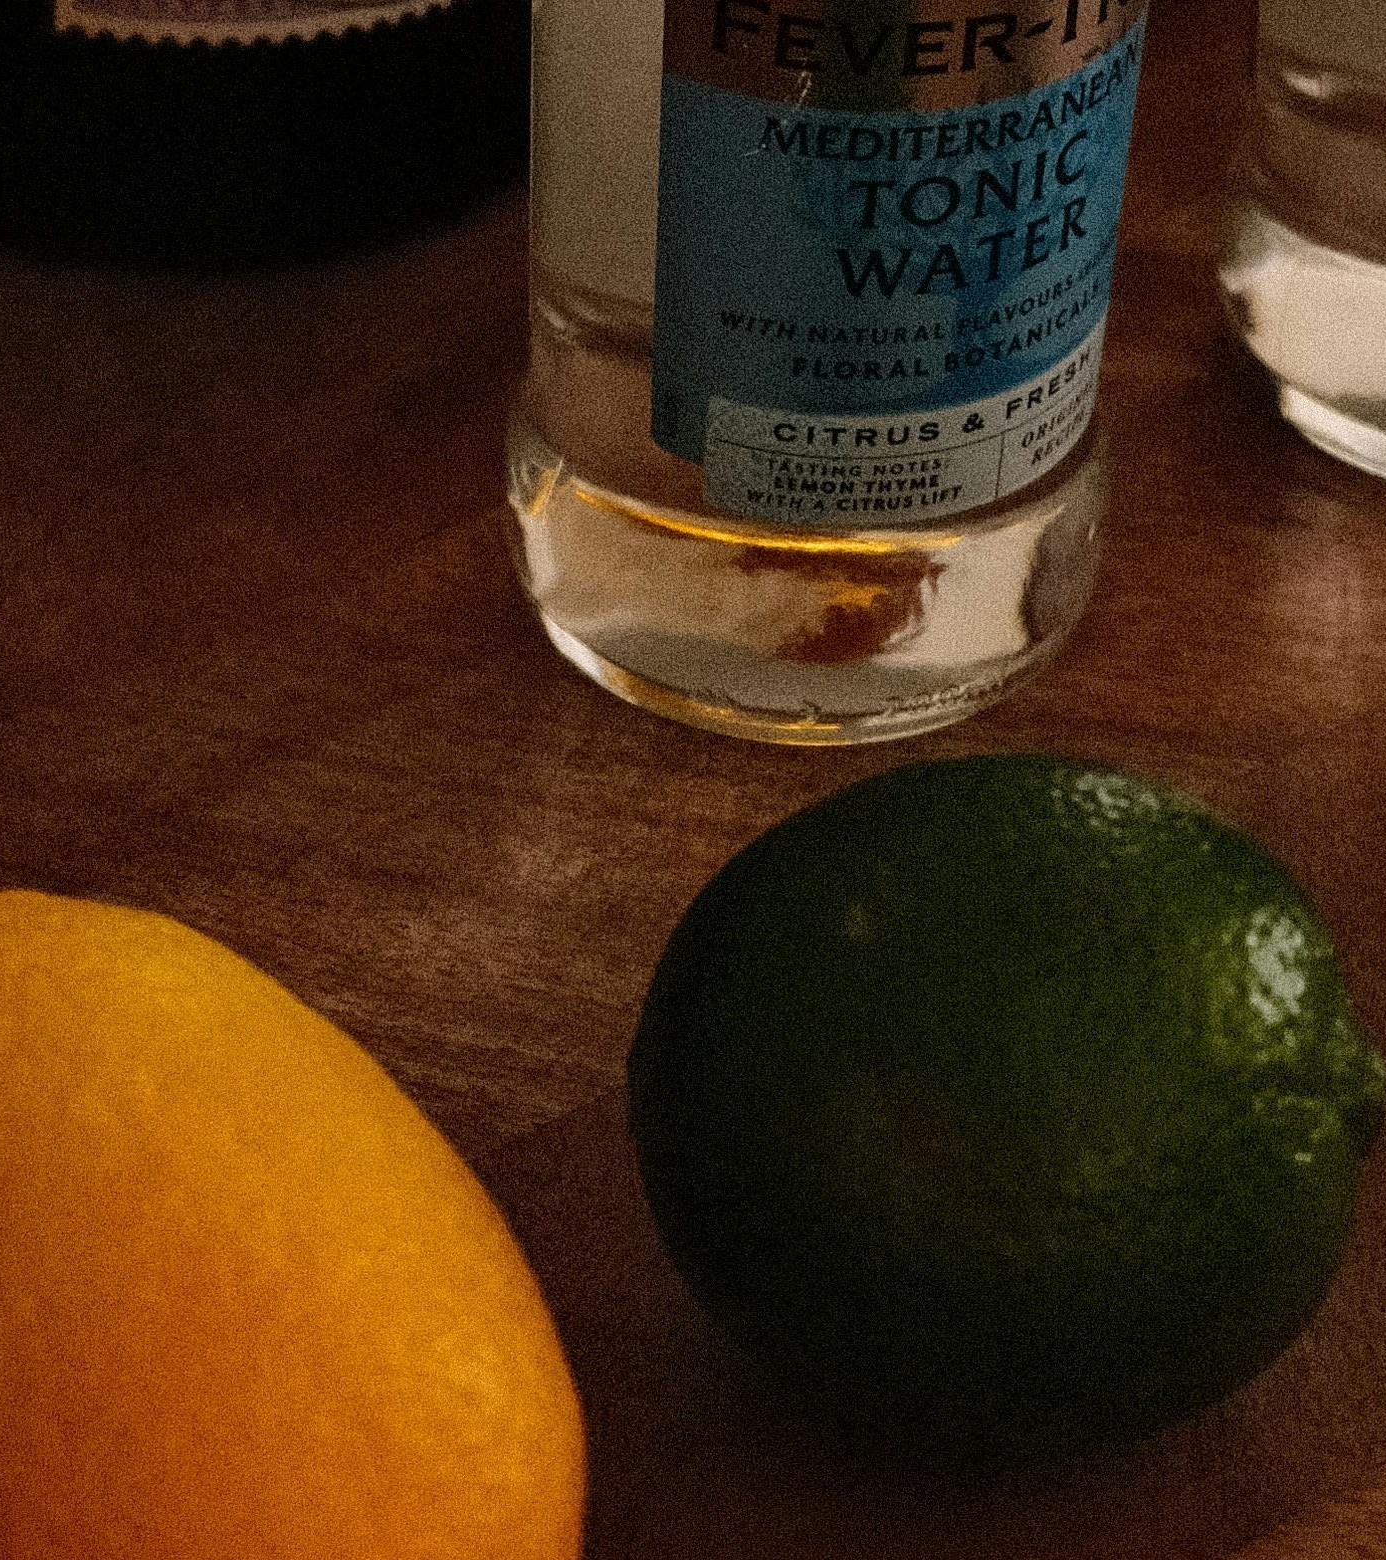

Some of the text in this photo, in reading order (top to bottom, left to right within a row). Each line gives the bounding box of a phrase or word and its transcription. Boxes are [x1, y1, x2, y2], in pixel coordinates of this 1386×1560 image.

[763, 35, 1141, 164] MEDITERRANEAN
[847, 130, 1090, 231] TONIC
[836, 196, 1088, 299] WATER
[719, 274, 1074, 347] WITH NATURAL FLAVOURS
[772, 345, 1091, 448] CITRUS & FRESH
[791, 356, 931, 383] FLORAL
[746, 484, 962, 512] WITH A CITRUS LIFT
[766, 458, 862, 478] TASTING
[773, 474, 940, 495] LEMON THYME
